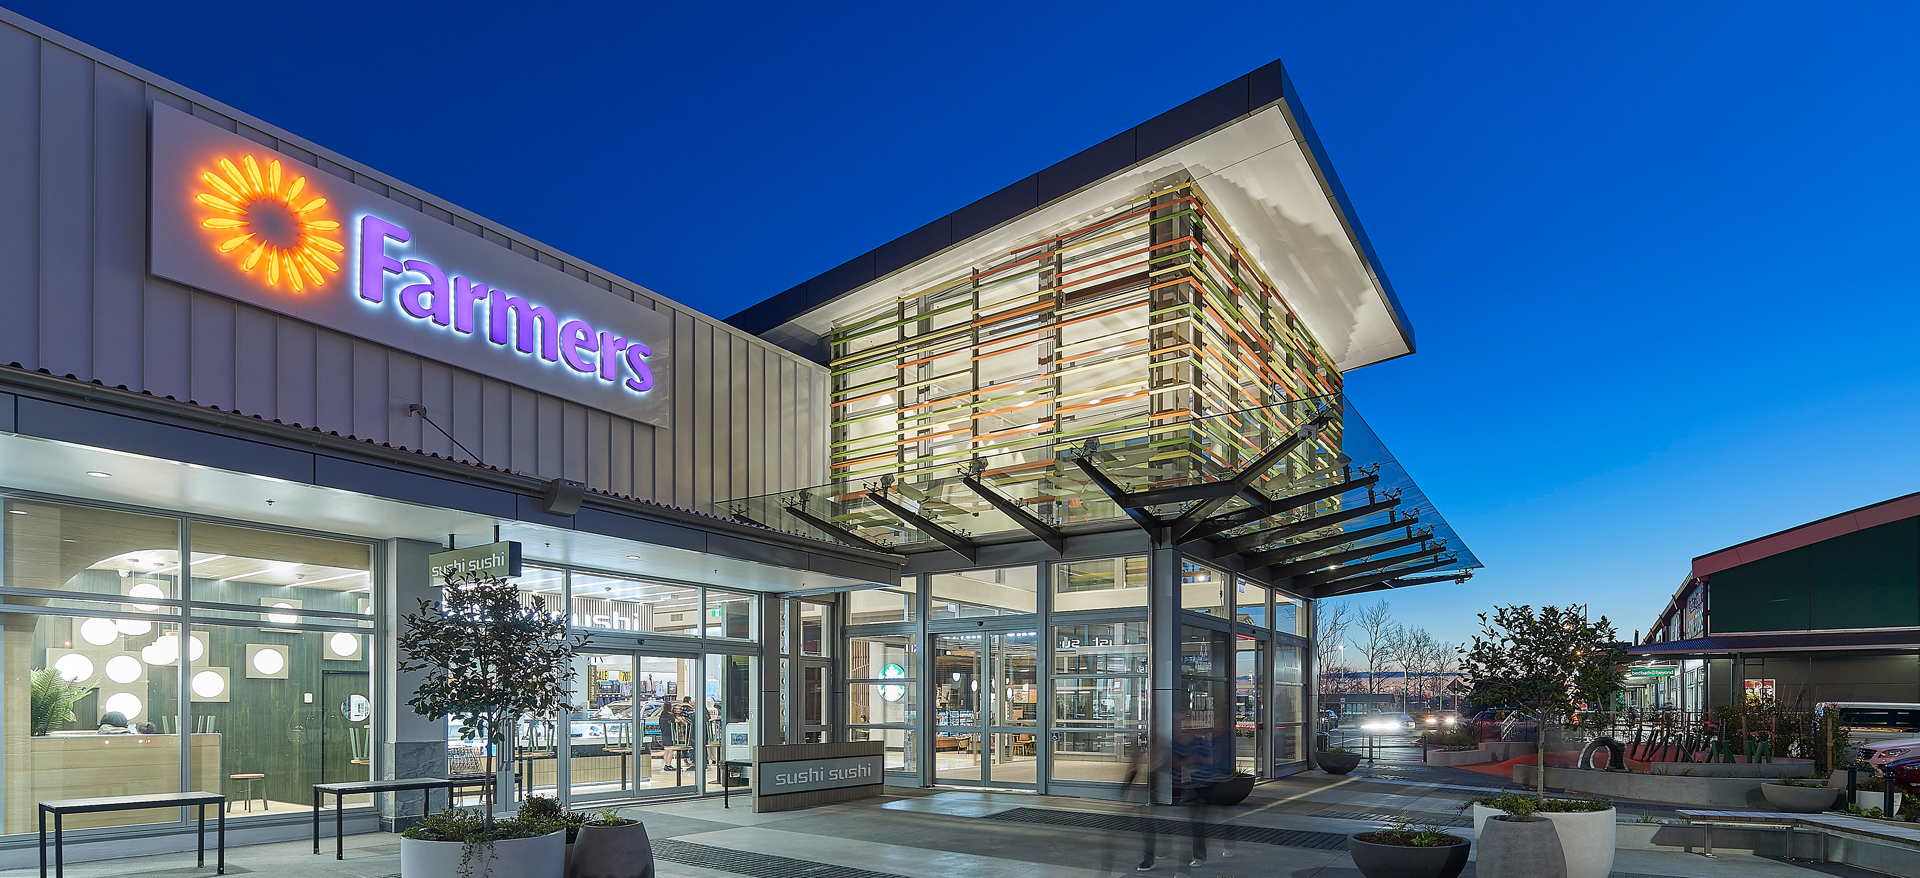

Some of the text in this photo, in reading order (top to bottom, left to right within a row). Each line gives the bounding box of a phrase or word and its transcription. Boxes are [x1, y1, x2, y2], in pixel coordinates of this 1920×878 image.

[359, 215, 655, 393] Farmers
[432, 551, 505, 577] sushi sushi
[775, 763, 871, 786] sushi sushi
